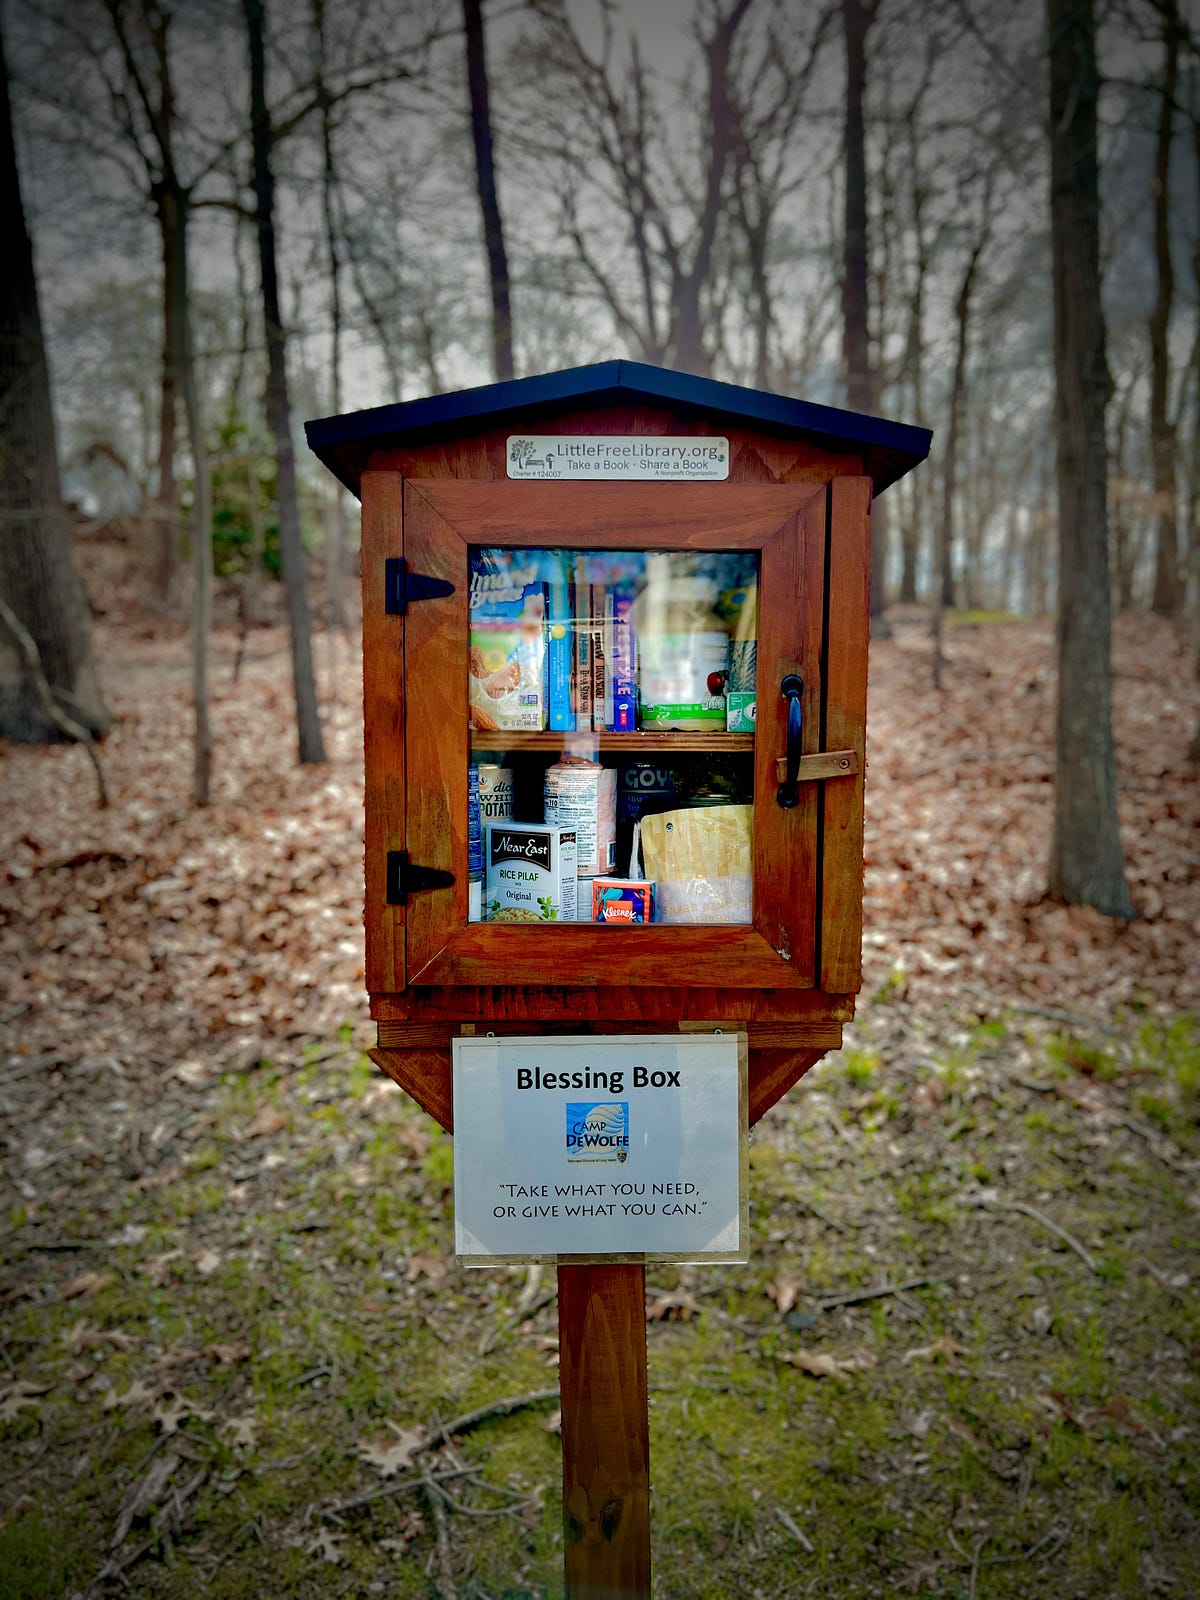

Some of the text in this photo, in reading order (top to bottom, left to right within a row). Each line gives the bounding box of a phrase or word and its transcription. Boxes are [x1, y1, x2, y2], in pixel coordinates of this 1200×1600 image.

[556, 443, 718, 459] LittleFreeLibrary.org
[567, 459, 709, 470] Take a Book Share a Book
[625, 769, 671, 789] GOY
[493, 836, 548, 857] Near East
[499, 869, 539, 882] RICE PILAF
[506, 890, 532, 901] Original
[602, 907, 637, 920] Kleenex
[516, 1065, 681, 1094] Blessing Box
[573, 1121, 607, 1136] CAMP
[555, 1184, 607, 1196] WHAT
[611, 1183, 646, 1195] YOU
[651, 1182, 700, 1197] NEED,
[493, 1205, 517, 1218] OR
[522, 1205, 559, 1218] GIVE
[565, 1204, 616, 1216] WHAT
[621, 1203, 656, 1216] YOU
